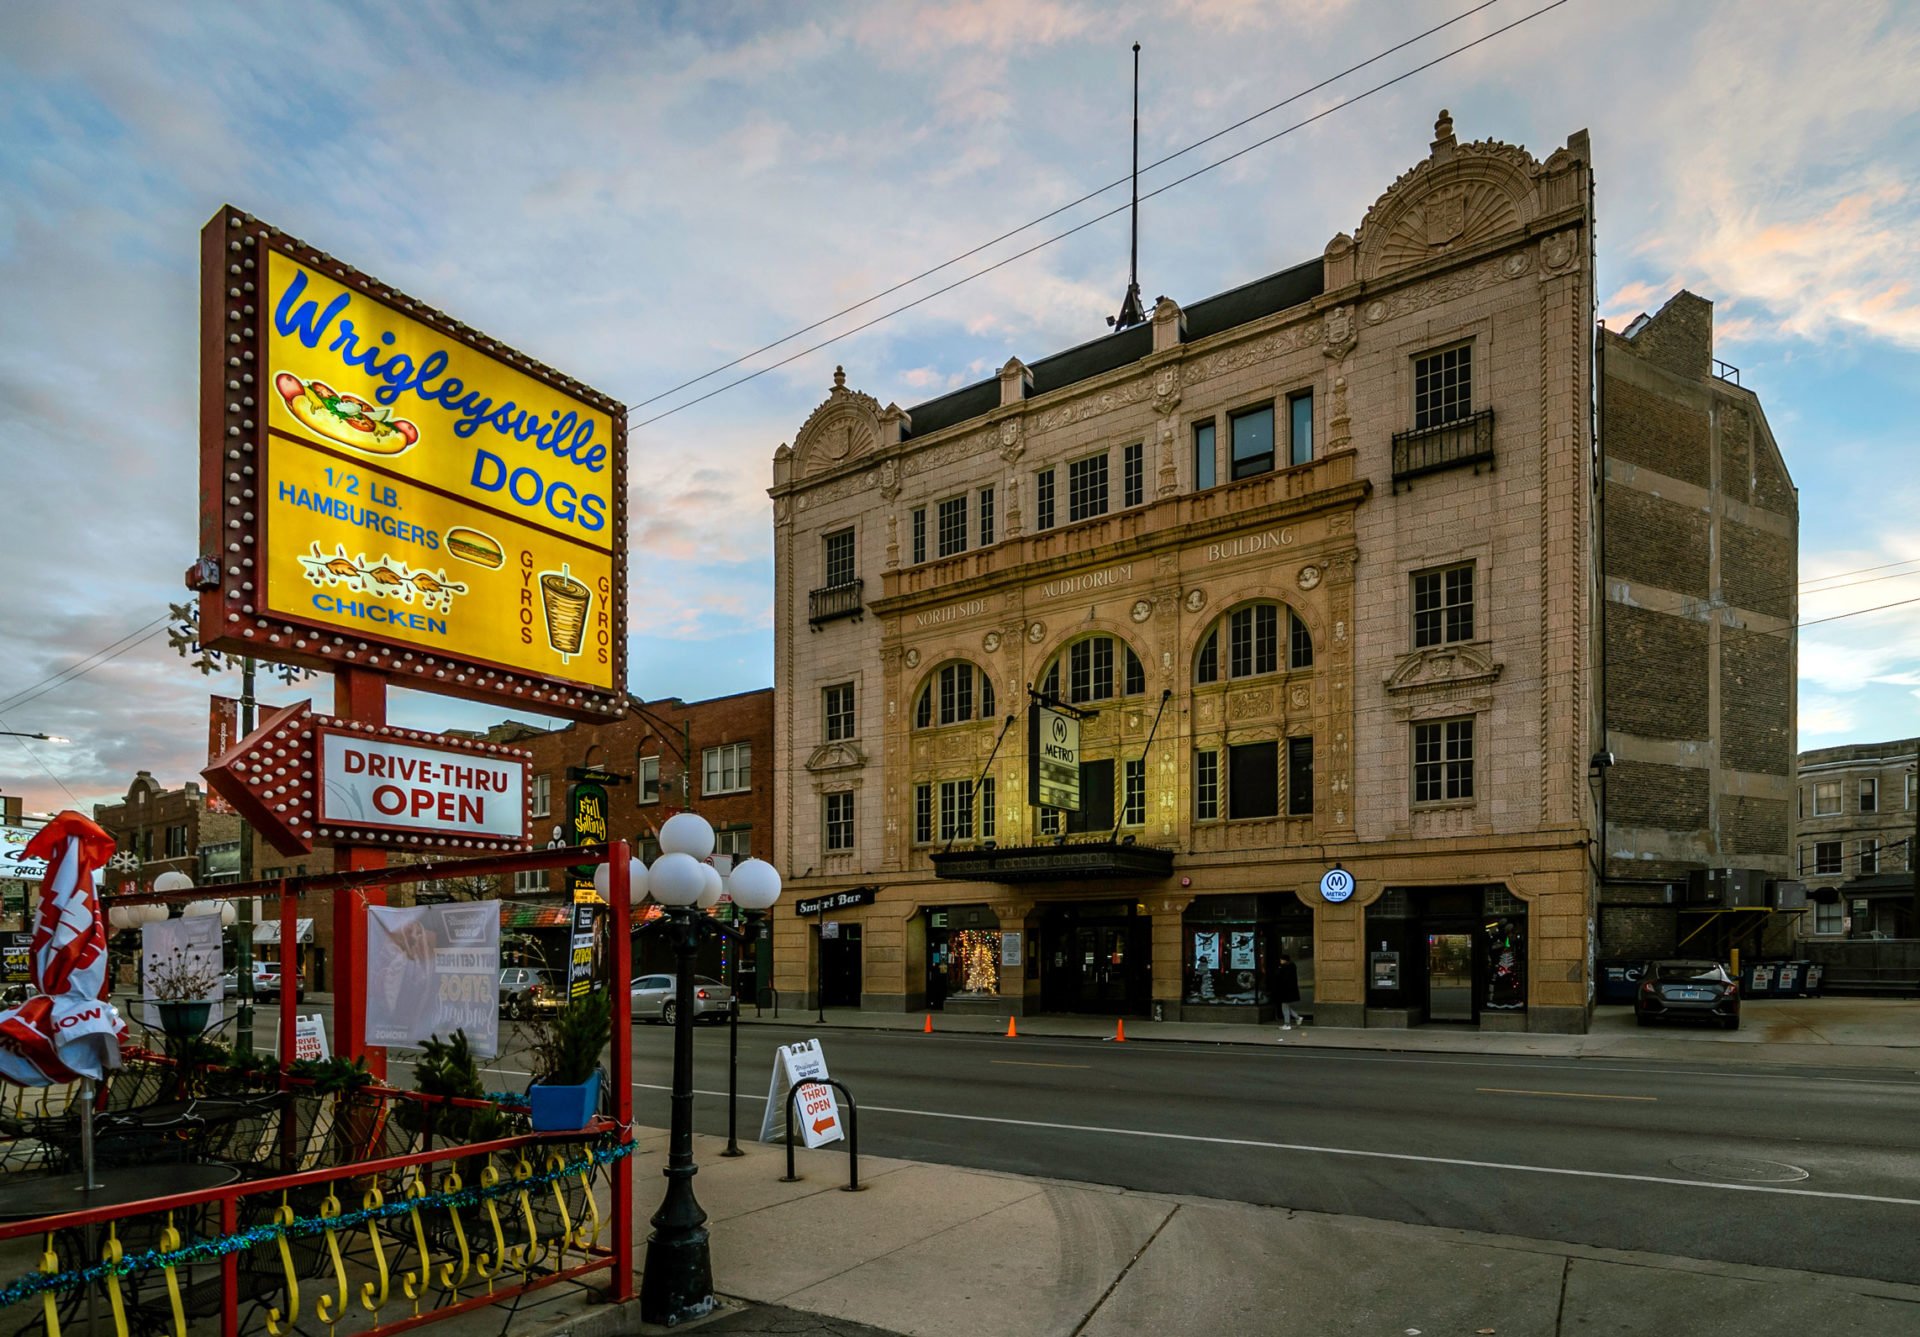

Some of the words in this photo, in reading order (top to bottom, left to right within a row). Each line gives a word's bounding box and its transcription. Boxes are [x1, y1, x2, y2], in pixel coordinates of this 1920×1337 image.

[274, 269, 607, 473] Wrigleysville
[323, 467, 359, 498] 1/2
[371, 482, 403, 512] LB.
[470, 449, 606, 533] DOGS
[277, 480, 440, 552] HAMBURGERS
[1207, 527, 1294, 563] BUILDING
[520, 550, 534, 646] GYROS
[1040, 564, 1134, 599] AUDITORIUM
[311, 592, 448, 637] CHICKEN
[597, 576, 610, 665] GYROS
[343, 748, 509, 794] DRIVE-THRU
[1045, 743, 1073, 763] METRO
[371, 784, 485, 825] OPEN
[579, 796, 601, 819] Full
[837, 893, 862, 906] Bar
[296, 1037, 320, 1045] RIVE-
[803, 1087, 826, 1101] THRU
[807, 1099, 830, 1115] OPEN
